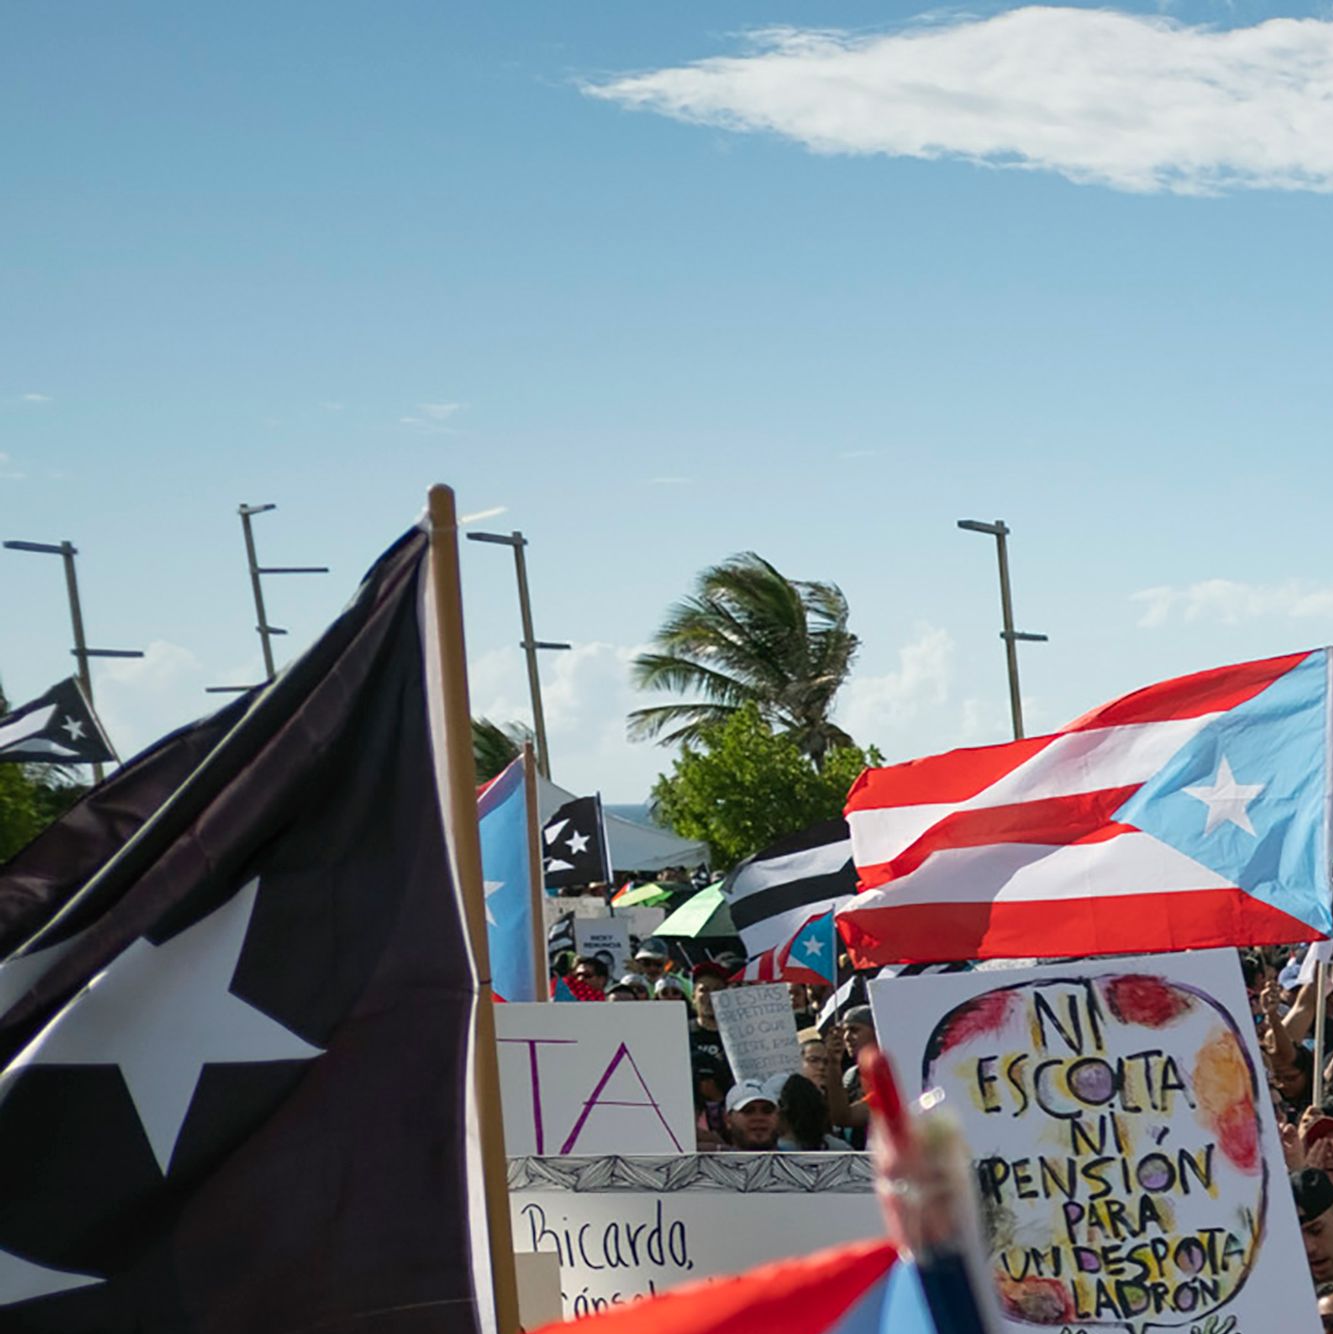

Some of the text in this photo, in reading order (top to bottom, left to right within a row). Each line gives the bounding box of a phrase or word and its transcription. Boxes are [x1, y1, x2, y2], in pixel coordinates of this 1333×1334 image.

[1031, 980, 1105, 1055] NI
[499, 1040, 683, 1155] TA
[976, 1050, 1197, 1119] ESCOLTA
[985, 1127, 1214, 1201] PENSIÓN
[522, 1200, 694, 1270] Ricardo,
[1062, 1194, 1163, 1244] PARA
[1002, 1245, 1061, 1281] UN
